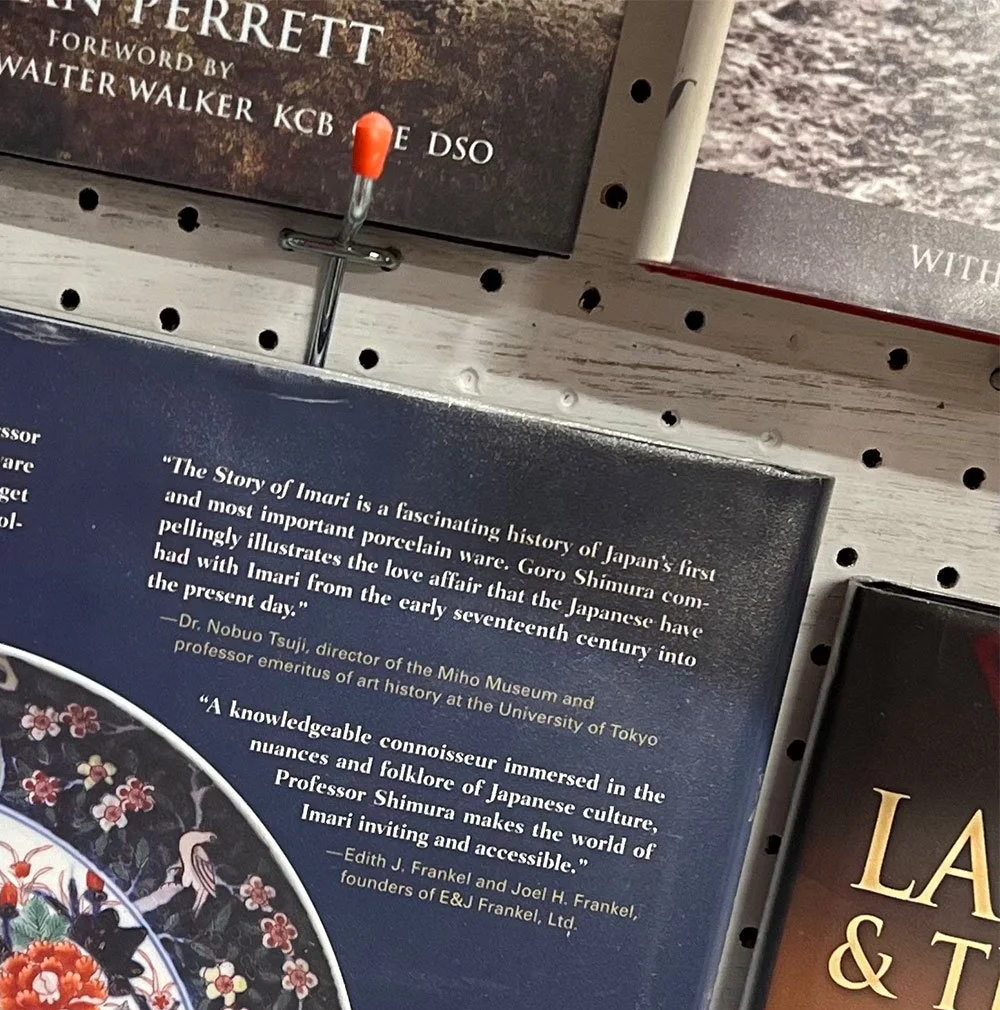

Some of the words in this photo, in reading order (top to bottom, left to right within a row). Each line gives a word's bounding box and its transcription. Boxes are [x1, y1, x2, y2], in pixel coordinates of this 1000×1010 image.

[49, 28, 194, 73] FOREWORD
[204, 59, 235, 81] BY
[129, 0, 384, 66] PERRETT
[128, 76, 254, 123] WALKER
[273, 103, 334, 137] KCB
[428, 131, 494, 165] DSO
[909, 244, 1000, 288] WITH
[148, 571, 179, 593] the
[183, 584, 255, 609] present
[164, 490, 202, 508] and
[208, 499, 253, 520] most
[260, 505, 355, 540] important
[361, 530, 452, 560] porcelain
[460, 550, 510, 571] ware.
[518, 558, 567, 582] Goro
[573, 568, 655, 600] Shimura
[662, 590, 710, 610] com-
[153, 541, 191, 566] had
[197, 555, 239, 576] with
[247, 562, 301, 588] Imari
[307, 573, 353, 599] from
[361, 585, 392, 606] the
[399, 598, 448, 621] early
[453, 609, 569, 642] seventeenth
[576, 634, 653, 663] century
[658, 645, 697, 668] into
[174, 640, 254, 665] professor
[258, 657, 331, 681] emeritus
[335, 671, 355, 685] of
[357, 677, 381, 691] art
[384, 678, 443, 706] history
[446, 695, 463, 708] at
[467, 696, 494, 713] the
[499, 702, 584, 734] University
[587, 722, 607, 736] of
[610, 723, 658, 747] Tokyo
[207, 619, 263, 643] Nobuo
[269, 631, 310, 655] Tsuji,
[316, 642, 381, 667] director
[385, 657, 404, 671] of
[407, 660, 433, 678] the
[437, 666, 480, 687] Miho
[485, 675, 558, 703] Museum
[562, 695, 595, 710] and
[229, 700, 372, 745] knowledgeable
[379, 737, 498, 770] connoisseur
[504, 757, 601, 791] immersed
[607, 778, 626, 797] in
[634, 783, 666, 804] the
[249, 740, 330, 766] nuances
[336, 757, 374, 775] and
[379, 760, 455, 791] folklore
[462, 779, 487, 797] of
[485, 783, 576, 815] Japanese
[583, 806, 658, 834] culture,
[274, 769, 367, 802] Professor
[373, 789, 455, 821] Shimura
[463, 812, 525, 834] makes
[532, 821, 564, 842] the
[572, 834, 627, 855] world
[633, 843, 658, 860] of
[301, 803, 354, 829] Imari
[358, 815, 430, 849] inviting
[434, 835, 471, 853] and
[340, 869, 414, 897] founders
[418, 888, 437, 902] of
[439, 890, 474, 909] E&J
[478, 897, 542, 926] Frankel,
[548, 912, 578, 931] Ltd.
[391, 857, 405, 873] J.
[411, 860, 472, 886] Frankel
[475, 877, 508, 893] and
[511, 882, 548, 901] Joel
[552, 889, 568, 906] H.
[574, 893, 638, 920] Frankel,
[828, 914, 897, 999] &
